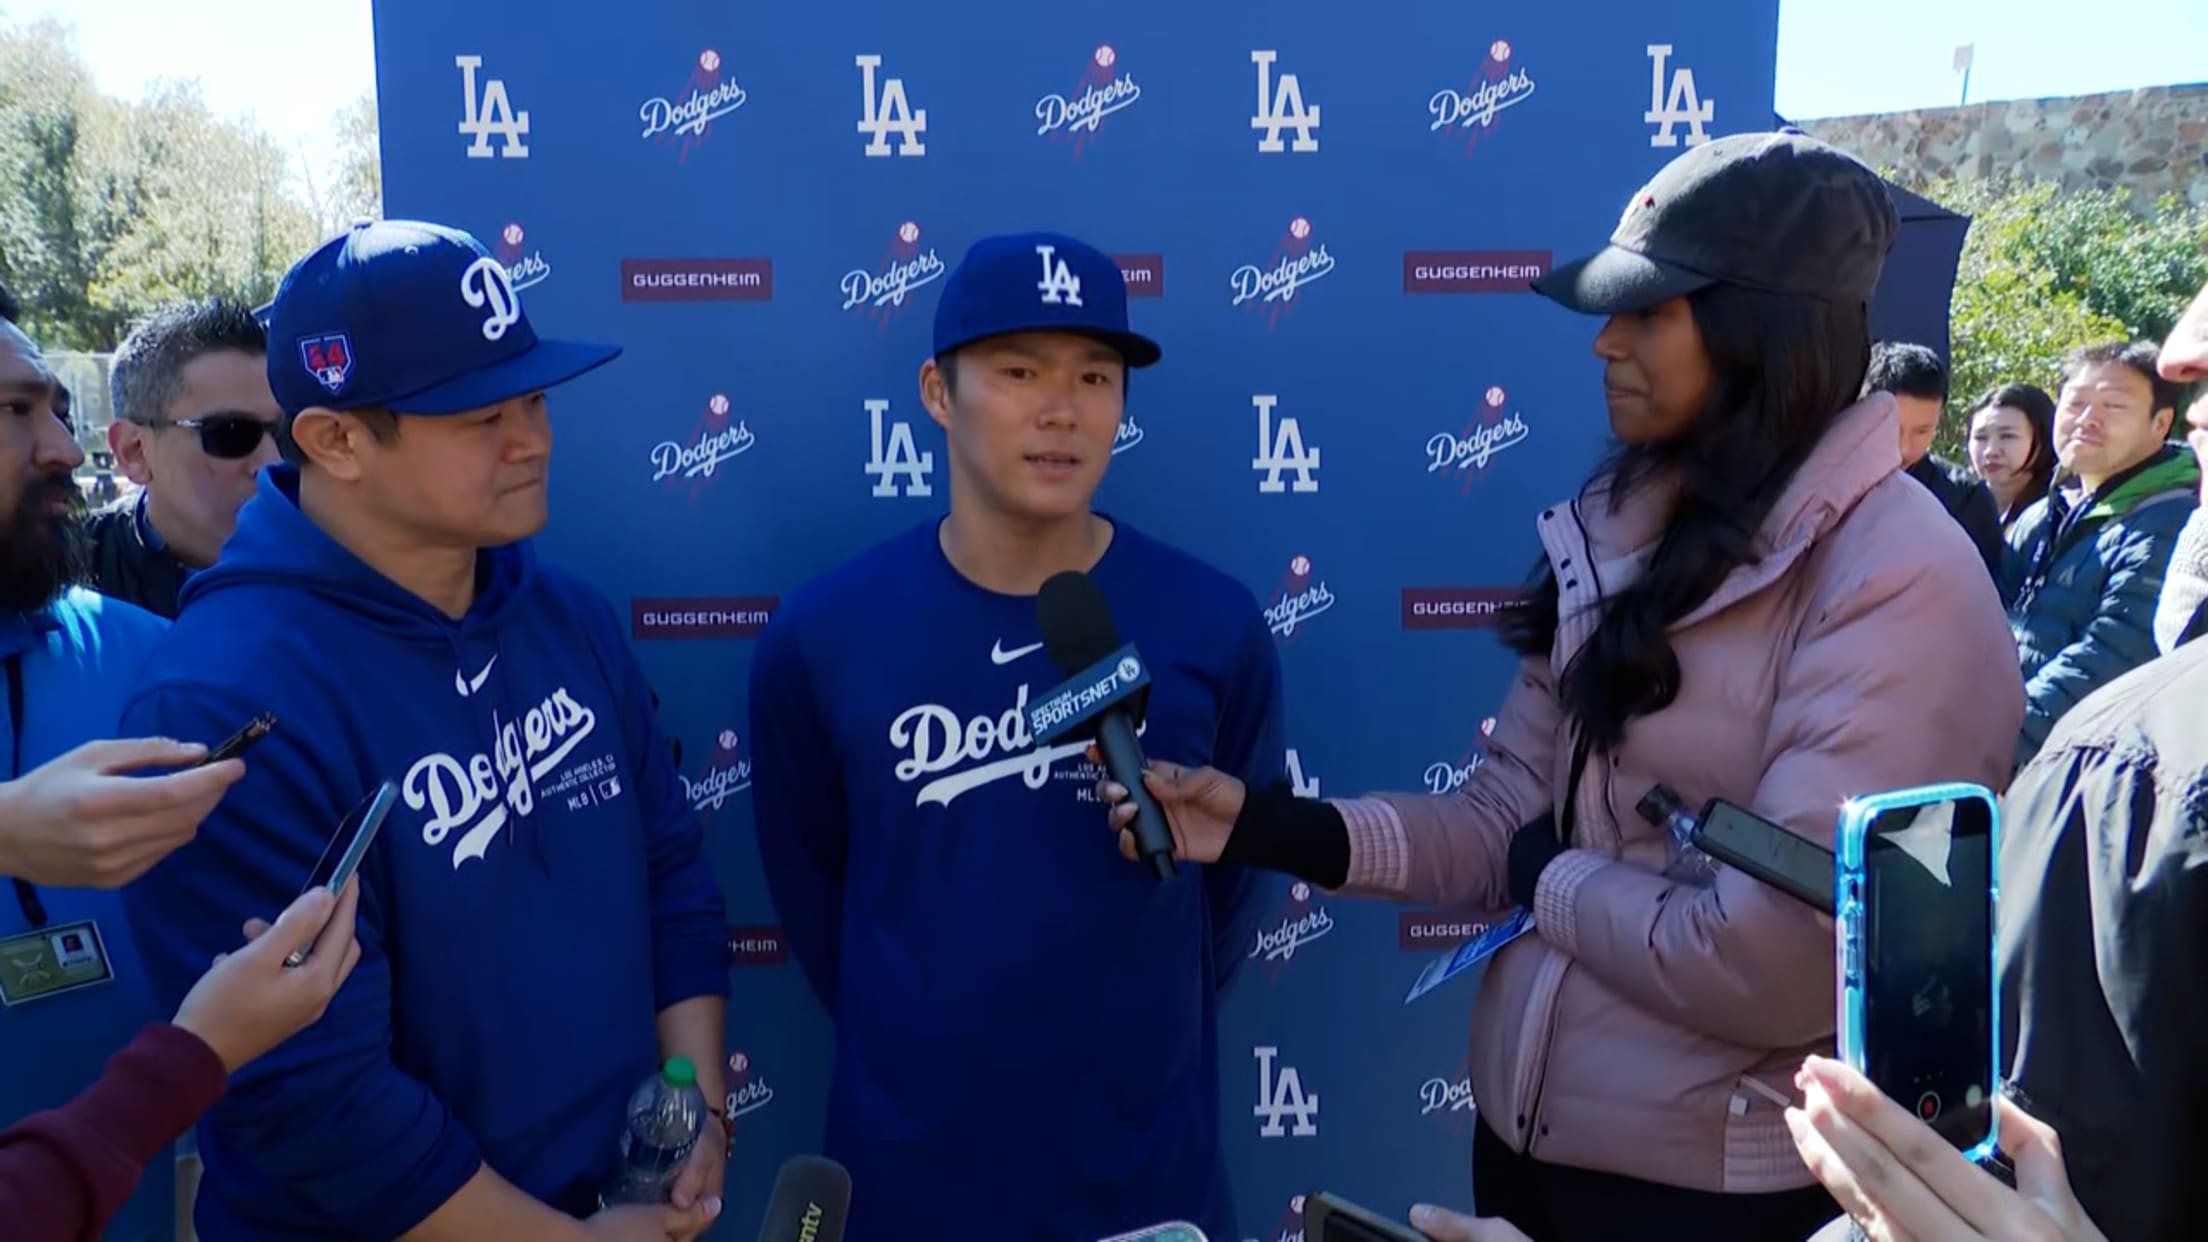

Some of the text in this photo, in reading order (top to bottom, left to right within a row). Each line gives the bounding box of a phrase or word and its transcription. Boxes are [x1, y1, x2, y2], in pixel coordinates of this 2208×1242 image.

[455, 55, 530, 158] LA
[639, 77, 746, 138] Dodgers
[856, 54, 927, 157] LA
[1036, 71, 1140, 135] Dodgers
[1251, 50, 1320, 152] LA
[1429, 66, 1535, 131] Dodgers
[1645, 44, 1714, 148] LA
[460, 256, 521, 341] D
[633, 273, 760, 287] GUGGENHEIM
[840, 248, 945, 310] Dodgers
[1036, 245, 1083, 307] LA
[1231, 243, 1335, 305] Dodgers
[1414, 265, 1541, 279] GUGGENHEIM
[650, 420, 755, 481] Dodgers
[864, 399, 933, 496] LA
[1252, 394, 1320, 493] LA
[1426, 411, 1529, 472] Dodgers
[643, 611, 769, 625] GUGGENHEIM
[1263, 581, 1335, 637] odgers
[1030, 689, 1073, 720] SPECTRUM
[1032, 671, 1119, 735] SPORTSNET
[402, 687, 596, 870] Dodgers
[679, 757, 752, 810] odger
[1410, 923, 1489, 937] GUGGEN
[1253, 1046, 1318, 1137] LA
